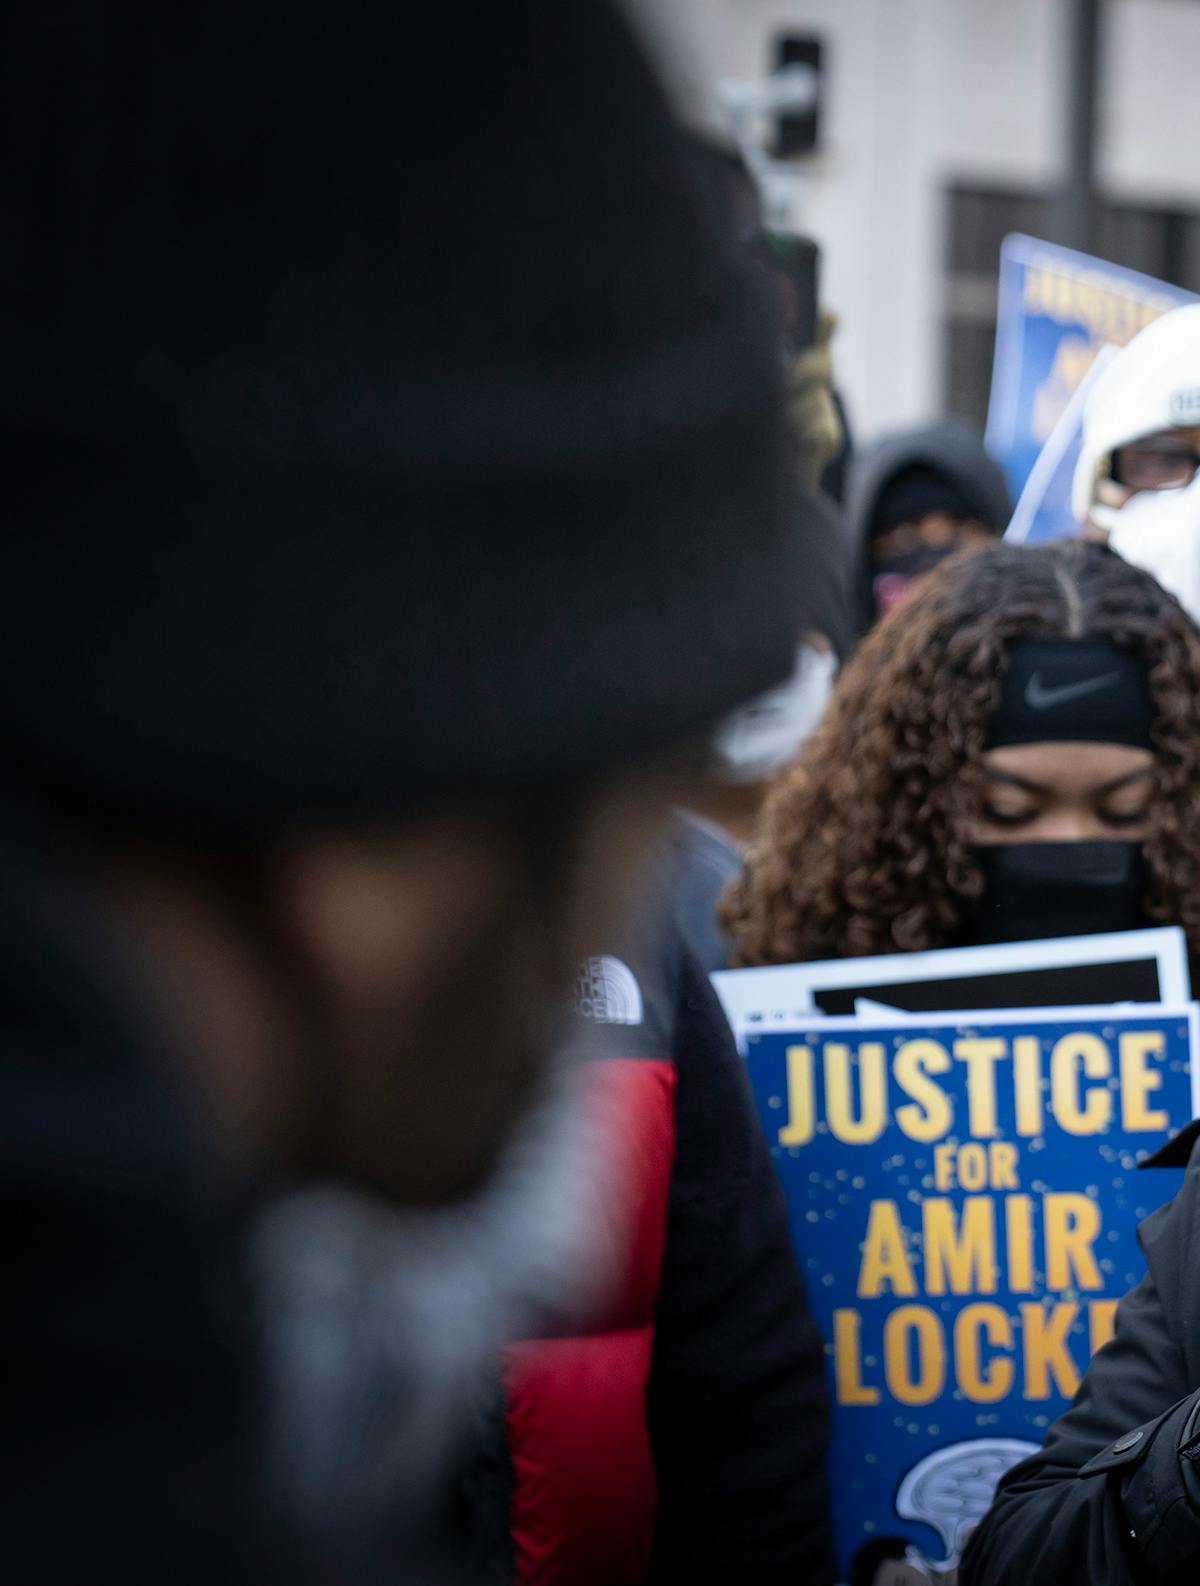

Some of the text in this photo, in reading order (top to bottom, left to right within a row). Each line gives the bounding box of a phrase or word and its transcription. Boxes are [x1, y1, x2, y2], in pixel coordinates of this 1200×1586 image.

[779, 1033, 1168, 1147] JUSTICE
[936, 1143, 1018, 1191] FOR
[858, 1193, 1104, 1297] AMIR
